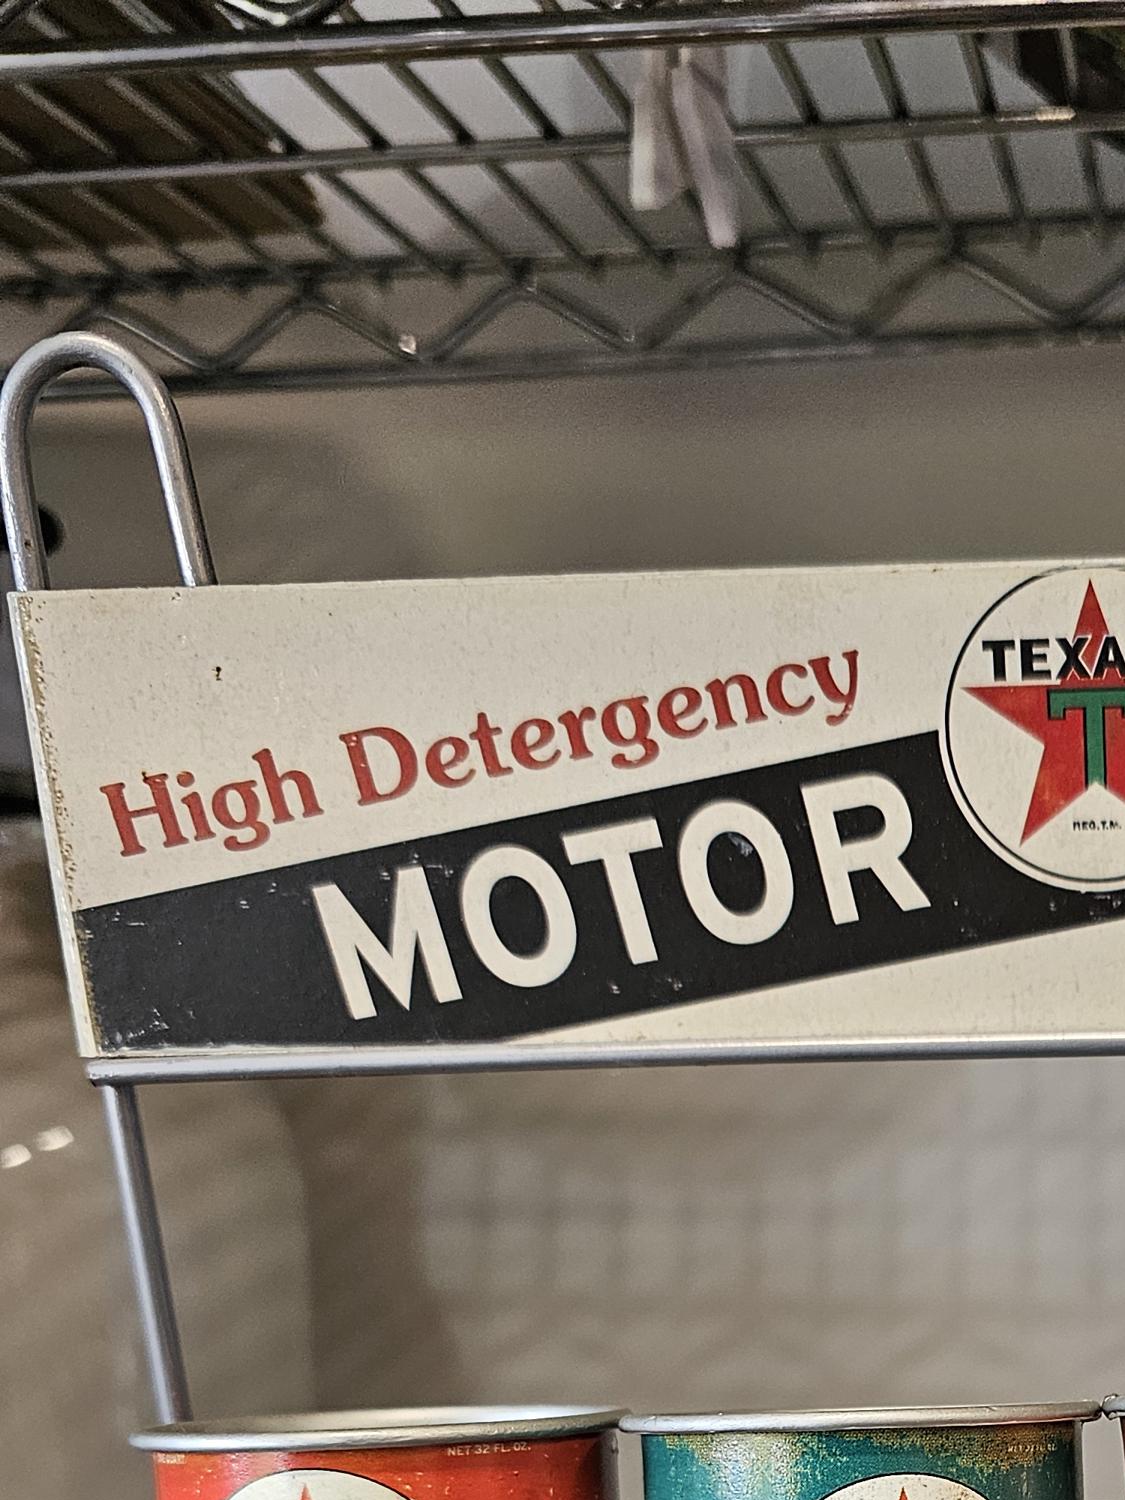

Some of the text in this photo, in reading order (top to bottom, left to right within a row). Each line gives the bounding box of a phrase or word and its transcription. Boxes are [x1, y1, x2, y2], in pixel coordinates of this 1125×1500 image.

[99, 650, 860, 858] High Detergency
[310, 774, 931, 1021] MOTOR
